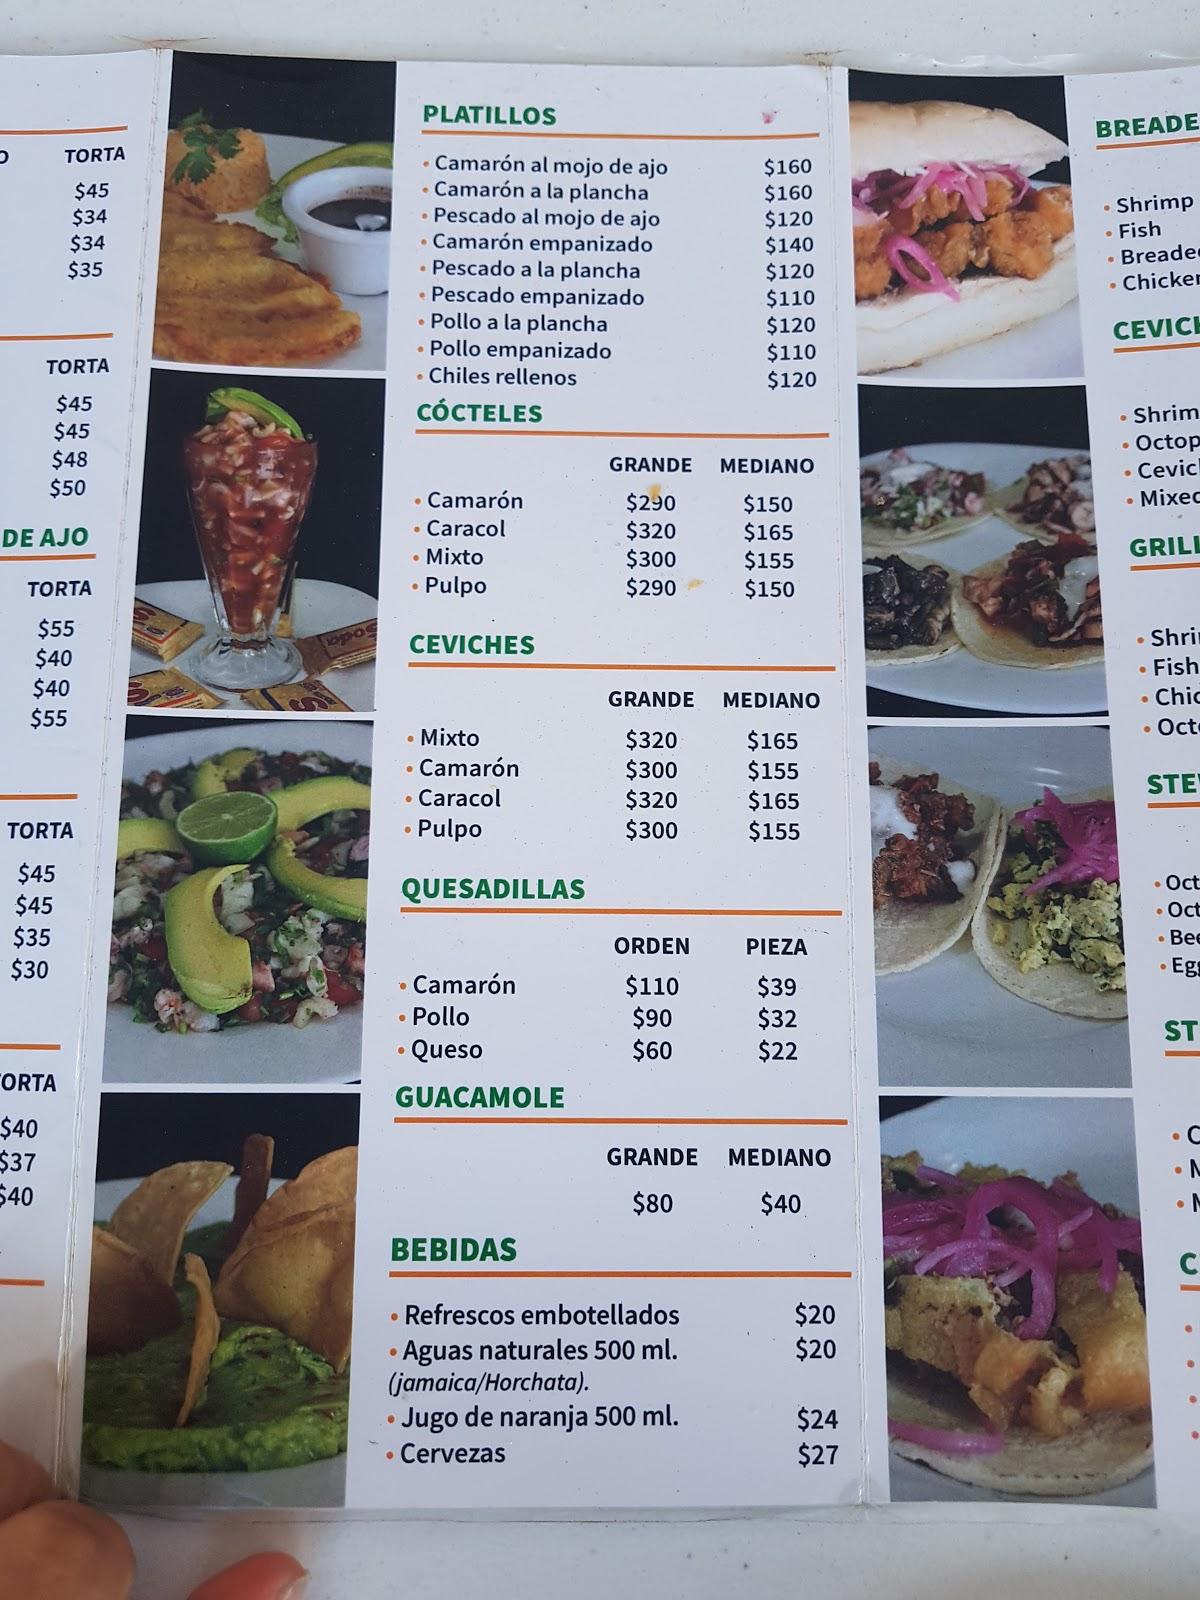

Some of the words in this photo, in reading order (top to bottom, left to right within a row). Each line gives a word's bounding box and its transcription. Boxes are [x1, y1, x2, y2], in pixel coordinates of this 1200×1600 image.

[423, 104, 557, 127] PLATILLOS
[1095, 112, 1200, 139] BREADE
[64, 146, 126, 164] TORTA
[434, 153, 525, 173] Camarón
[530, 155, 549, 174] al
[553, 157, 604, 178] mojo
[608, 157, 634, 175] de
[638, 158, 668, 180] ajo
[764, 157, 812, 178] $160
[74, 181, 110, 202] $45
[434, 179, 525, 199] Camarón
[530, 186, 542, 199] a
[547, 182, 564, 200] la
[569, 183, 649, 204] plancha
[764, 184, 813, 204] $160
[1116, 194, 1194, 214] Shrimp
[72, 207, 108, 228] $34
[434, 206, 517, 225] Pescado
[521, 207, 540, 225] al
[544, 208, 595, 231] mojo
[600, 209, 625, 227] de
[629, 214, 661, 233] ajo
[765, 209, 814, 230] $120
[1118, 220, 1162, 239] Fish
[69, 233, 106, 254] $34
[432, 232, 524, 251] Camarón
[529, 235, 654, 256] empanizado
[765, 235, 814, 256] $140
[1120, 243, 1200, 266] Breade
[67, 260, 103, 281] $35
[432, 259, 516, 277] Pescado
[520, 264, 532, 278] a
[537, 260, 555, 278] la
[560, 260, 641, 282] plancha
[766, 262, 815, 283] $120
[431, 285, 515, 304] Pescado
[520, 287, 645, 309] empanizado
[766, 288, 816, 310] $110
[431, 312, 482, 330] Pollo
[487, 317, 499, 331] a
[504, 312, 521, 331] la
[527, 313, 608, 335] plancha
[766, 315, 816, 337] $120
[430, 339, 481, 358] Pollo
[486, 341, 612, 362] empanizado
[767, 342, 817, 364] $110
[45, 357, 110, 375] TORTA
[428, 366, 491, 385] Chiles
[495, 367, 577, 387] rellenos
[767, 370, 817, 391] $120
[55, 394, 93, 415] $45
[416, 397, 543, 424] CÓCTELES
[53, 421, 91, 443] $45
[51, 449, 88, 471] $48
[609, 456, 693, 473] GRANDE
[720, 457, 815, 474] MEDIANO
[1137, 457, 1200, 480] Cevic
[49, 477, 87, 500] $50
[427, 489, 523, 510] Camarón
[626, 492, 676, 514] $290
[743, 493, 793, 515] $150
[1, 528, 35, 548] DE
[38, 526, 89, 548] AJO
[426, 519, 506, 538] Caracol
[626, 520, 677, 542] $320
[744, 521, 794, 543] $165
[426, 546, 484, 566] Mixto
[626, 548, 677, 570] $300
[744, 549, 795, 572] $155
[27, 579, 93, 598] TORTA
[425, 575, 487, 598] Pulpo
[626, 576, 677, 599] $290
[745, 578, 795, 600] $150
[37, 617, 75, 641] $55
[1150, 626, 1200, 648] Shri
[409, 634, 535, 656] CEVICHES
[35, 647, 73, 671] $40
[1153, 656, 1200, 677] Fish
[32, 677, 71, 700] $40
[608, 690, 695, 708] GRANDE
[723, 691, 821, 709] MEDIANO
[30, 707, 68, 730] $55
[1157, 717, 1200, 737] Oct
[420, 727, 480, 747] Mixto
[625, 728, 678, 752] $320
[747, 729, 799, 753] $165
[419, 756, 519, 778] Camarón
[625, 758, 678, 782] $300
[747, 759, 799, 783] $155
[1146, 772, 1200, 795] STE
[418, 788, 501, 808] Caracol
[625, 788, 678, 811] $320
[748, 789, 800, 812] $165
[7, 821, 74, 840] TORTA
[418, 817, 483, 843] Pulpo
[625, 818, 678, 842] $300
[748, 819, 801, 843] $155
[17, 861, 56, 886] $45
[401, 877, 586, 905] QUESADILLAS
[15, 893, 53, 918] $45
[13, 925, 51, 950] $35
[614, 936, 690, 955] ORDEN
[746, 937, 809, 956] PIEZA
[10, 957, 49, 982] $30
[413, 972, 516, 995] Camarón
[625, 973, 680, 999] $110
[757, 975, 797, 999] $39
[412, 1005, 470, 1027] Pollo
[632, 1005, 673, 1031] $90
[758, 1006, 798, 1031] $32
[411, 1038, 483, 1064] Queso
[632, 1038, 673, 1063] $60
[758, 1038, 798, 1064] $22
[0, 1072, 57, 1093] ORTA
[395, 1085, 565, 1109] GUACAMOLE
[0, 1115, 39, 1141] $40
[0, 1149, 37, 1175] $37
[606, 1147, 699, 1167] GRANDE
[728, 1147, 832, 1168] MEDIANO
[632, 1190, 674, 1217] $80
[761, 1191, 802, 1217] $40
[391, 1236, 517, 1262] BEBIDAS
[405, 1302, 516, 1326] Refrescos
[521, 1302, 680, 1326] embotellados
[795, 1301, 836, 1328] $20
[402, 1339, 473, 1367] Aguas
[479, 1337, 589, 1361] naturales
[593, 1339, 636, 1361] 500
[642, 1337, 678, 1361] ml.
[795, 1336, 837, 1363] $20
[388, 1370, 589, 1398] (jamaica/Horchata).
[401, 1406, 459, 1434] Jugo
[464, 1404, 494, 1428] de
[500, 1404, 588, 1433] naranja
[594, 1405, 637, 1427] 500
[642, 1403, 679, 1427] ml.
[797, 1406, 839, 1433] $24
[400, 1442, 506, 1464] Cervezas
[798, 1441, 839, 1469] $27
